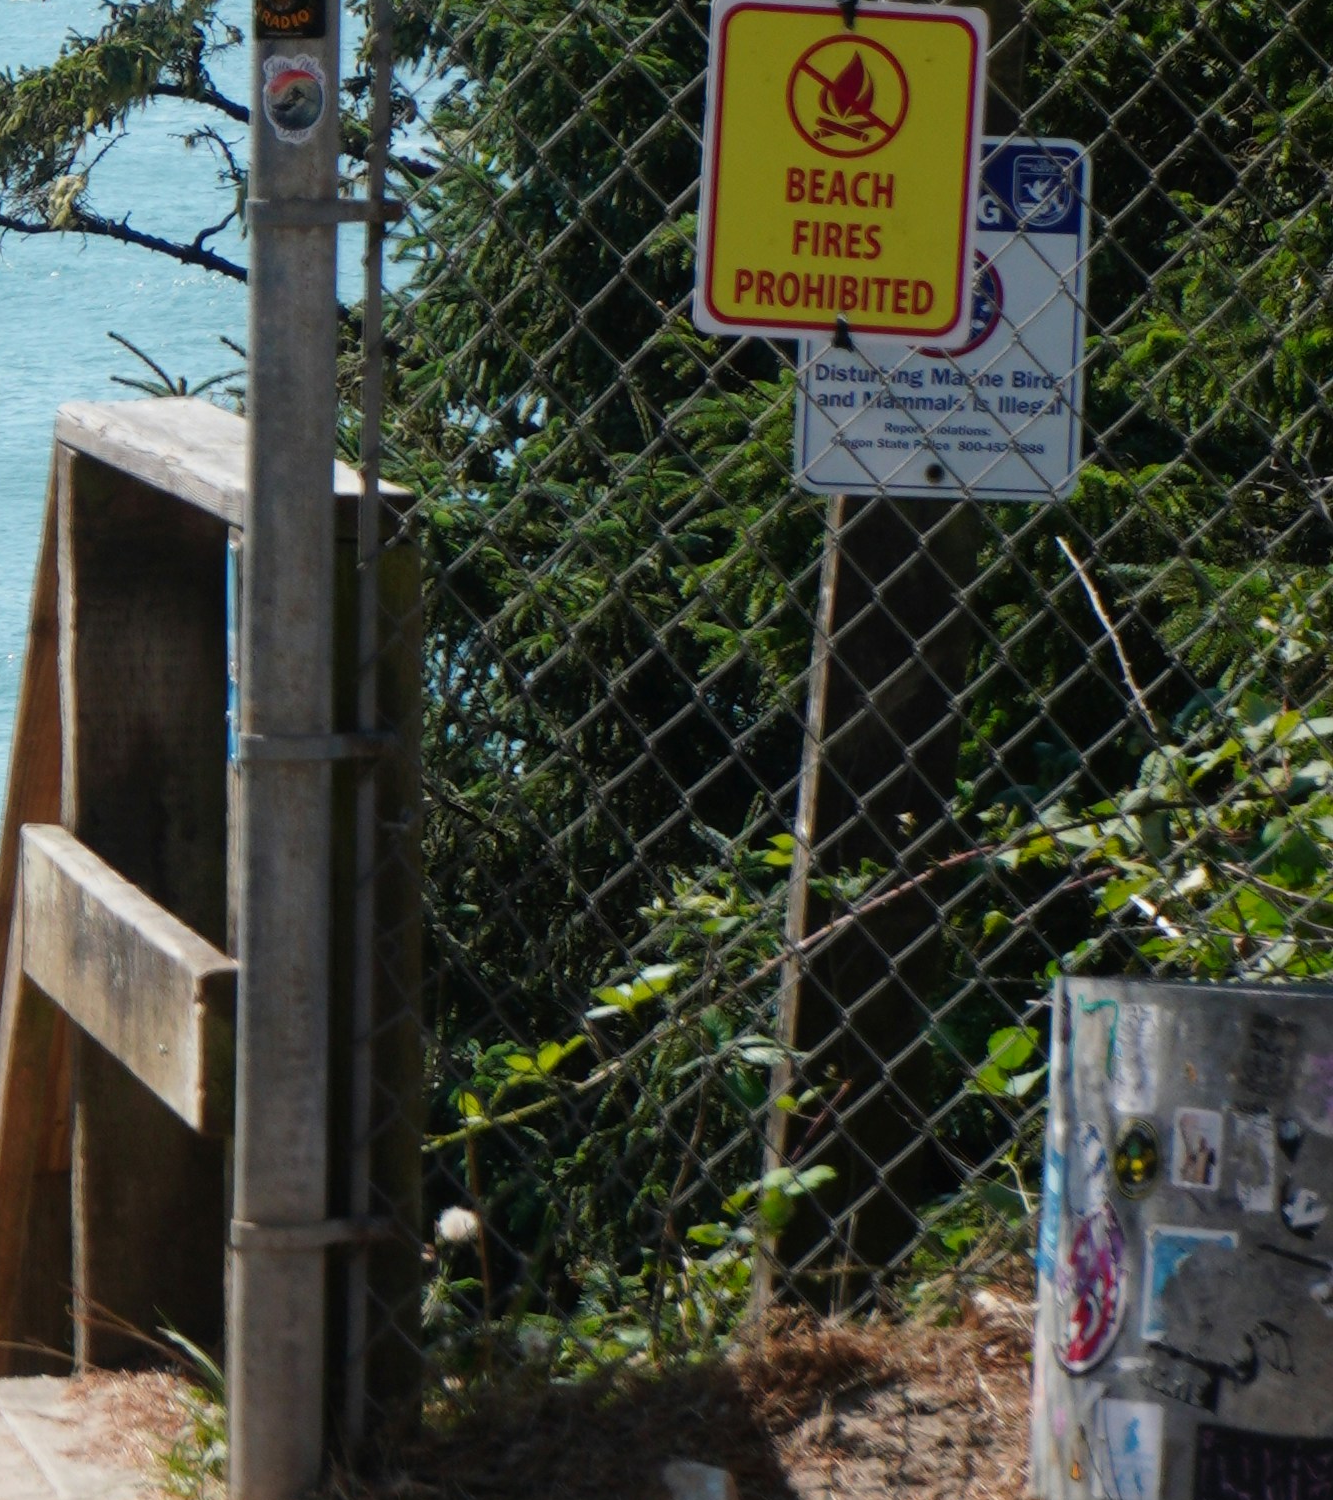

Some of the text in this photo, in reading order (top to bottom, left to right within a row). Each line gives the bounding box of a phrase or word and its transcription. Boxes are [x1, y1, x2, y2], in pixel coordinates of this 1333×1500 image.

[262, 8, 310, 30] RADIO
[786, 166, 895, 208] BEACH
[792, 219, 882, 261] FIRES
[733, 268, 935, 316] PROHIBITED
[817, 391, 855, 408] and
[863, 391, 965, 412] Mammals
[927, 424, 991, 437] iolations:
[876, 438, 909, 449] State
[914, 439, 950, 451] Pice
[957, 441, 1045, 454] 800-452888
